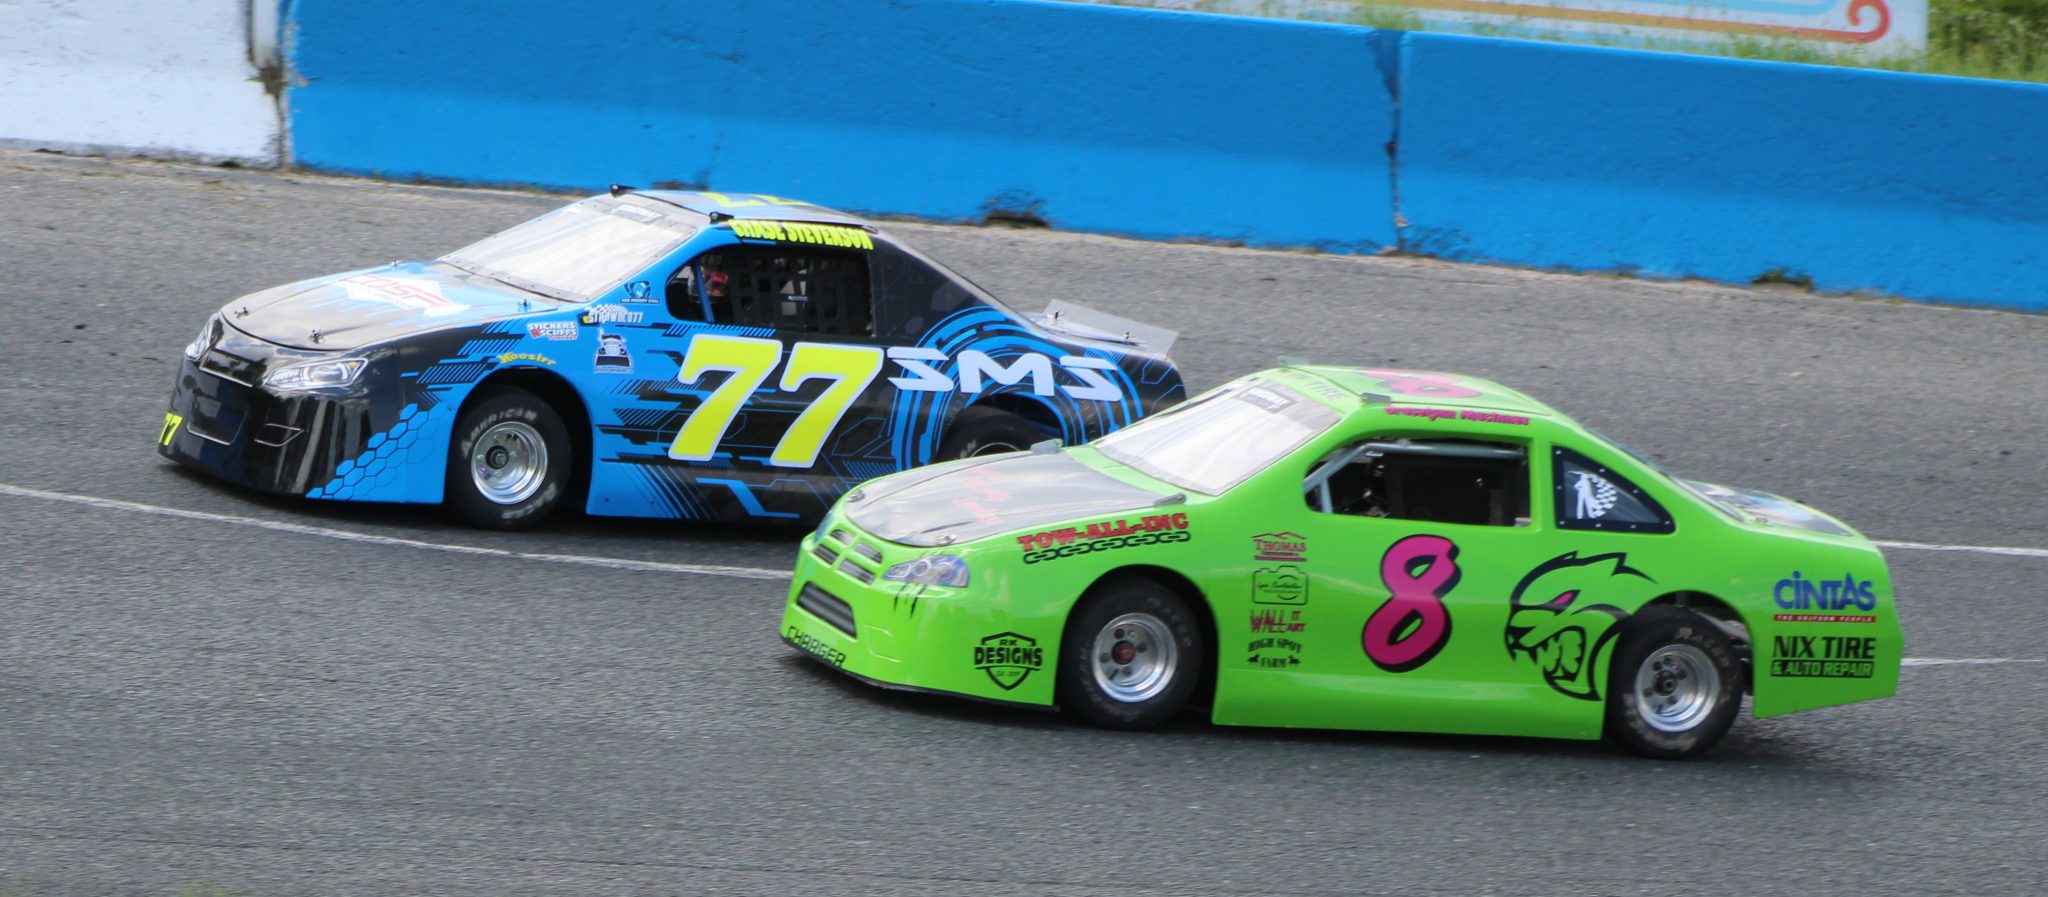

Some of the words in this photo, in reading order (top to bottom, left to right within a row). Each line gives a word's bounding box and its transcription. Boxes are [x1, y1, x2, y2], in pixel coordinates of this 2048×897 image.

[728, 218, 787, 242] CHASE
[782, 221, 874, 250] STEVENSON
[528, 321, 577, 330] STICKERS
[887, 346, 1122, 401] SMS
[668, 335, 884, 468] 77
[158, 412, 183, 446] 77
[1016, 513, 1189, 552] TOW-ALL-INC
[1361, 534, 1462, 673] 8
[787, 625, 846, 667] CHARGER
[974, 646, 1043, 666] DESIGNS
[1773, 635, 1817, 658] NIX
[1822, 637, 1877, 659] TIRE
[1772, 661, 1782, 675] &
[1783, 661, 1820, 676] AUTO
[1823, 662, 1872, 677] REPAIR
